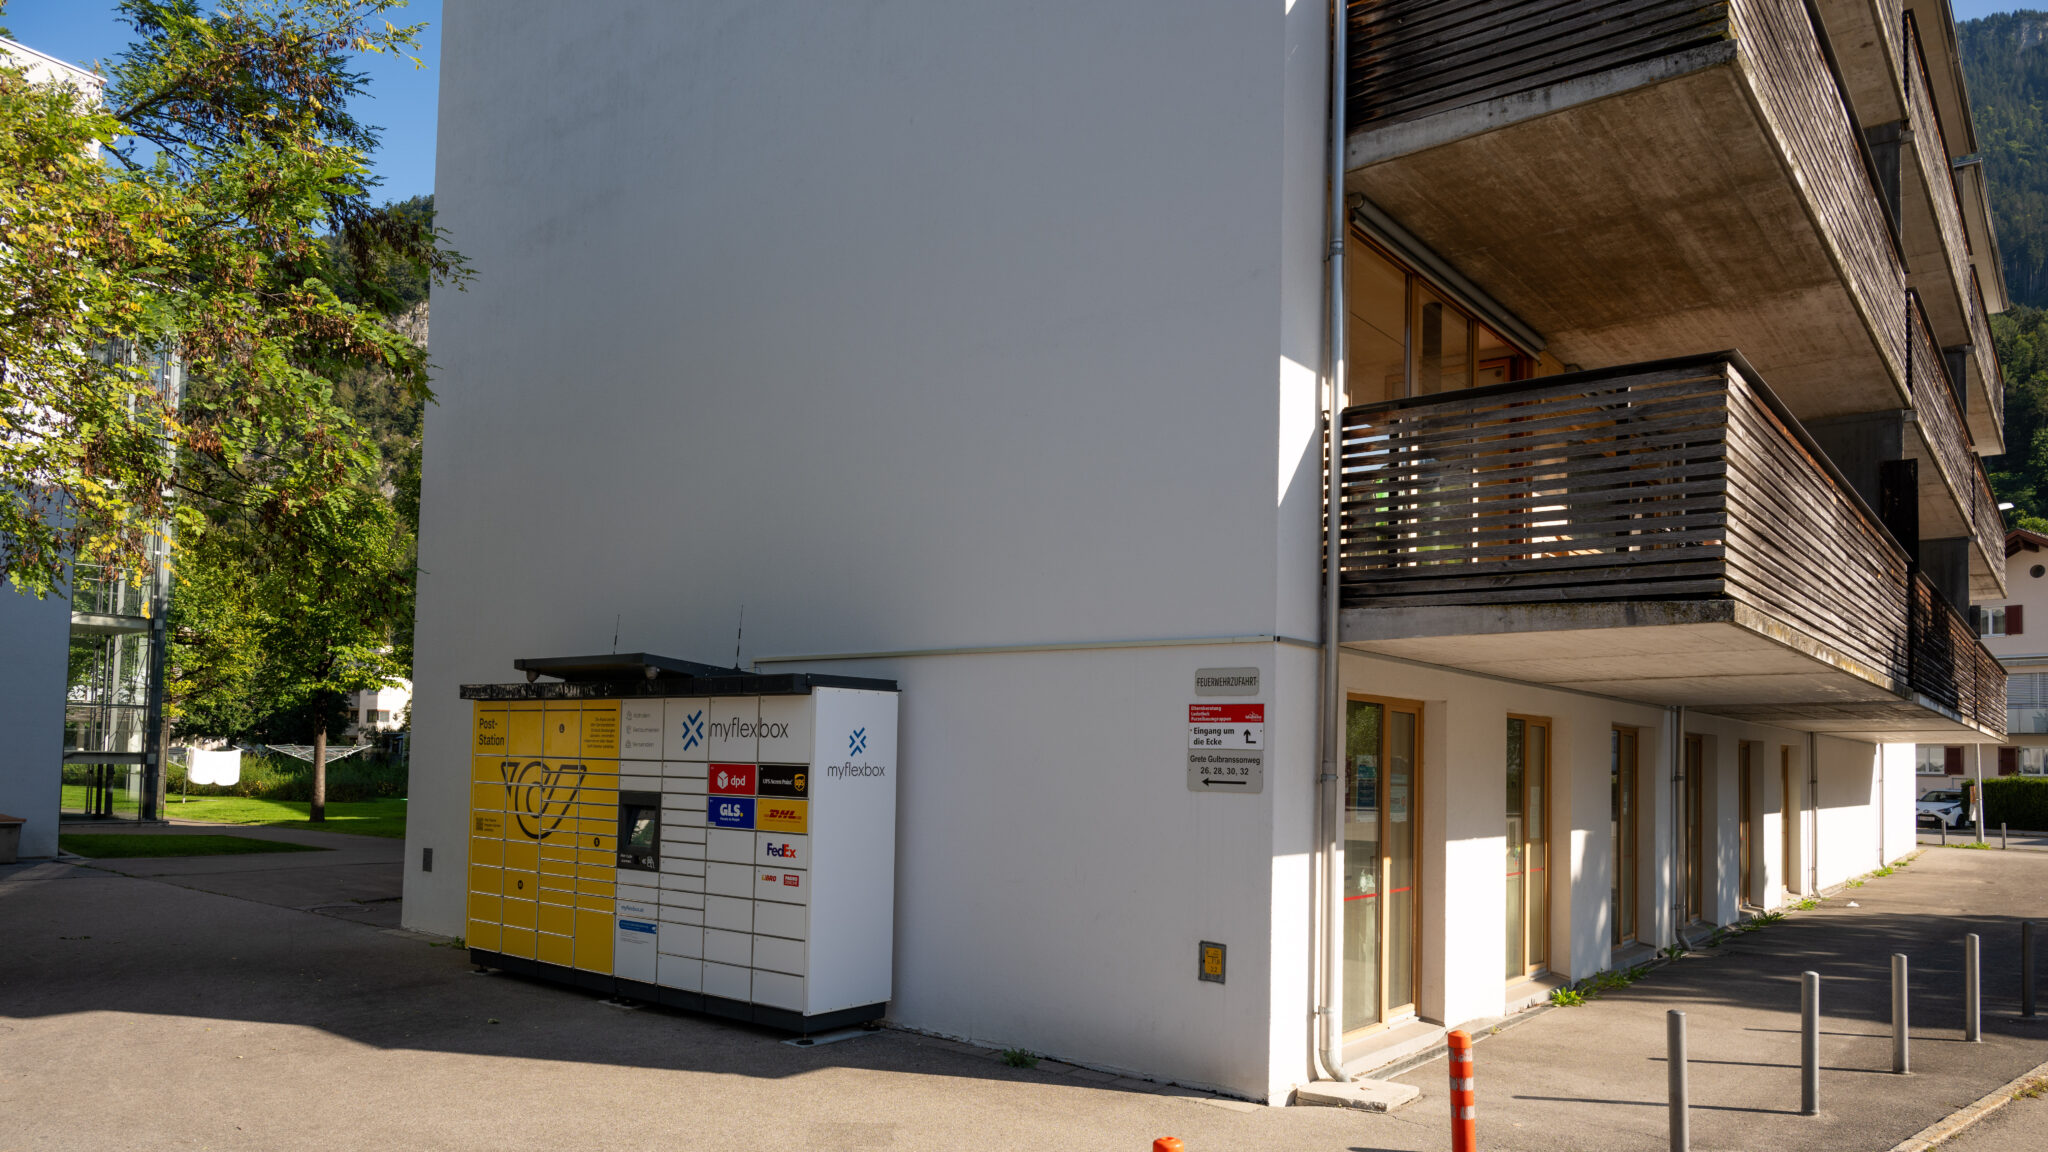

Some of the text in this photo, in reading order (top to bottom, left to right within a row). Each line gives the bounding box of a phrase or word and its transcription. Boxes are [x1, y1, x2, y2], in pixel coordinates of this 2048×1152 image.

[1196, 676, 1257, 687] FEUERWEHRZUFAHRT
[479, 718, 498, 730] Post-
[709, 717, 789, 742] myflexbox
[1193, 727, 1222, 736] Eingang
[478, 734, 505, 746] Station
[1190, 755, 1261, 766] Grete Gulbranssonweg
[827, 761, 886, 781] myflexbox
[1200, 766, 1249, 776] 26, 28, 30, 32
[730, 775, 746, 788] dpd
[769, 808, 797, 820] DHL
[766, 842, 797, 859] FedEx
